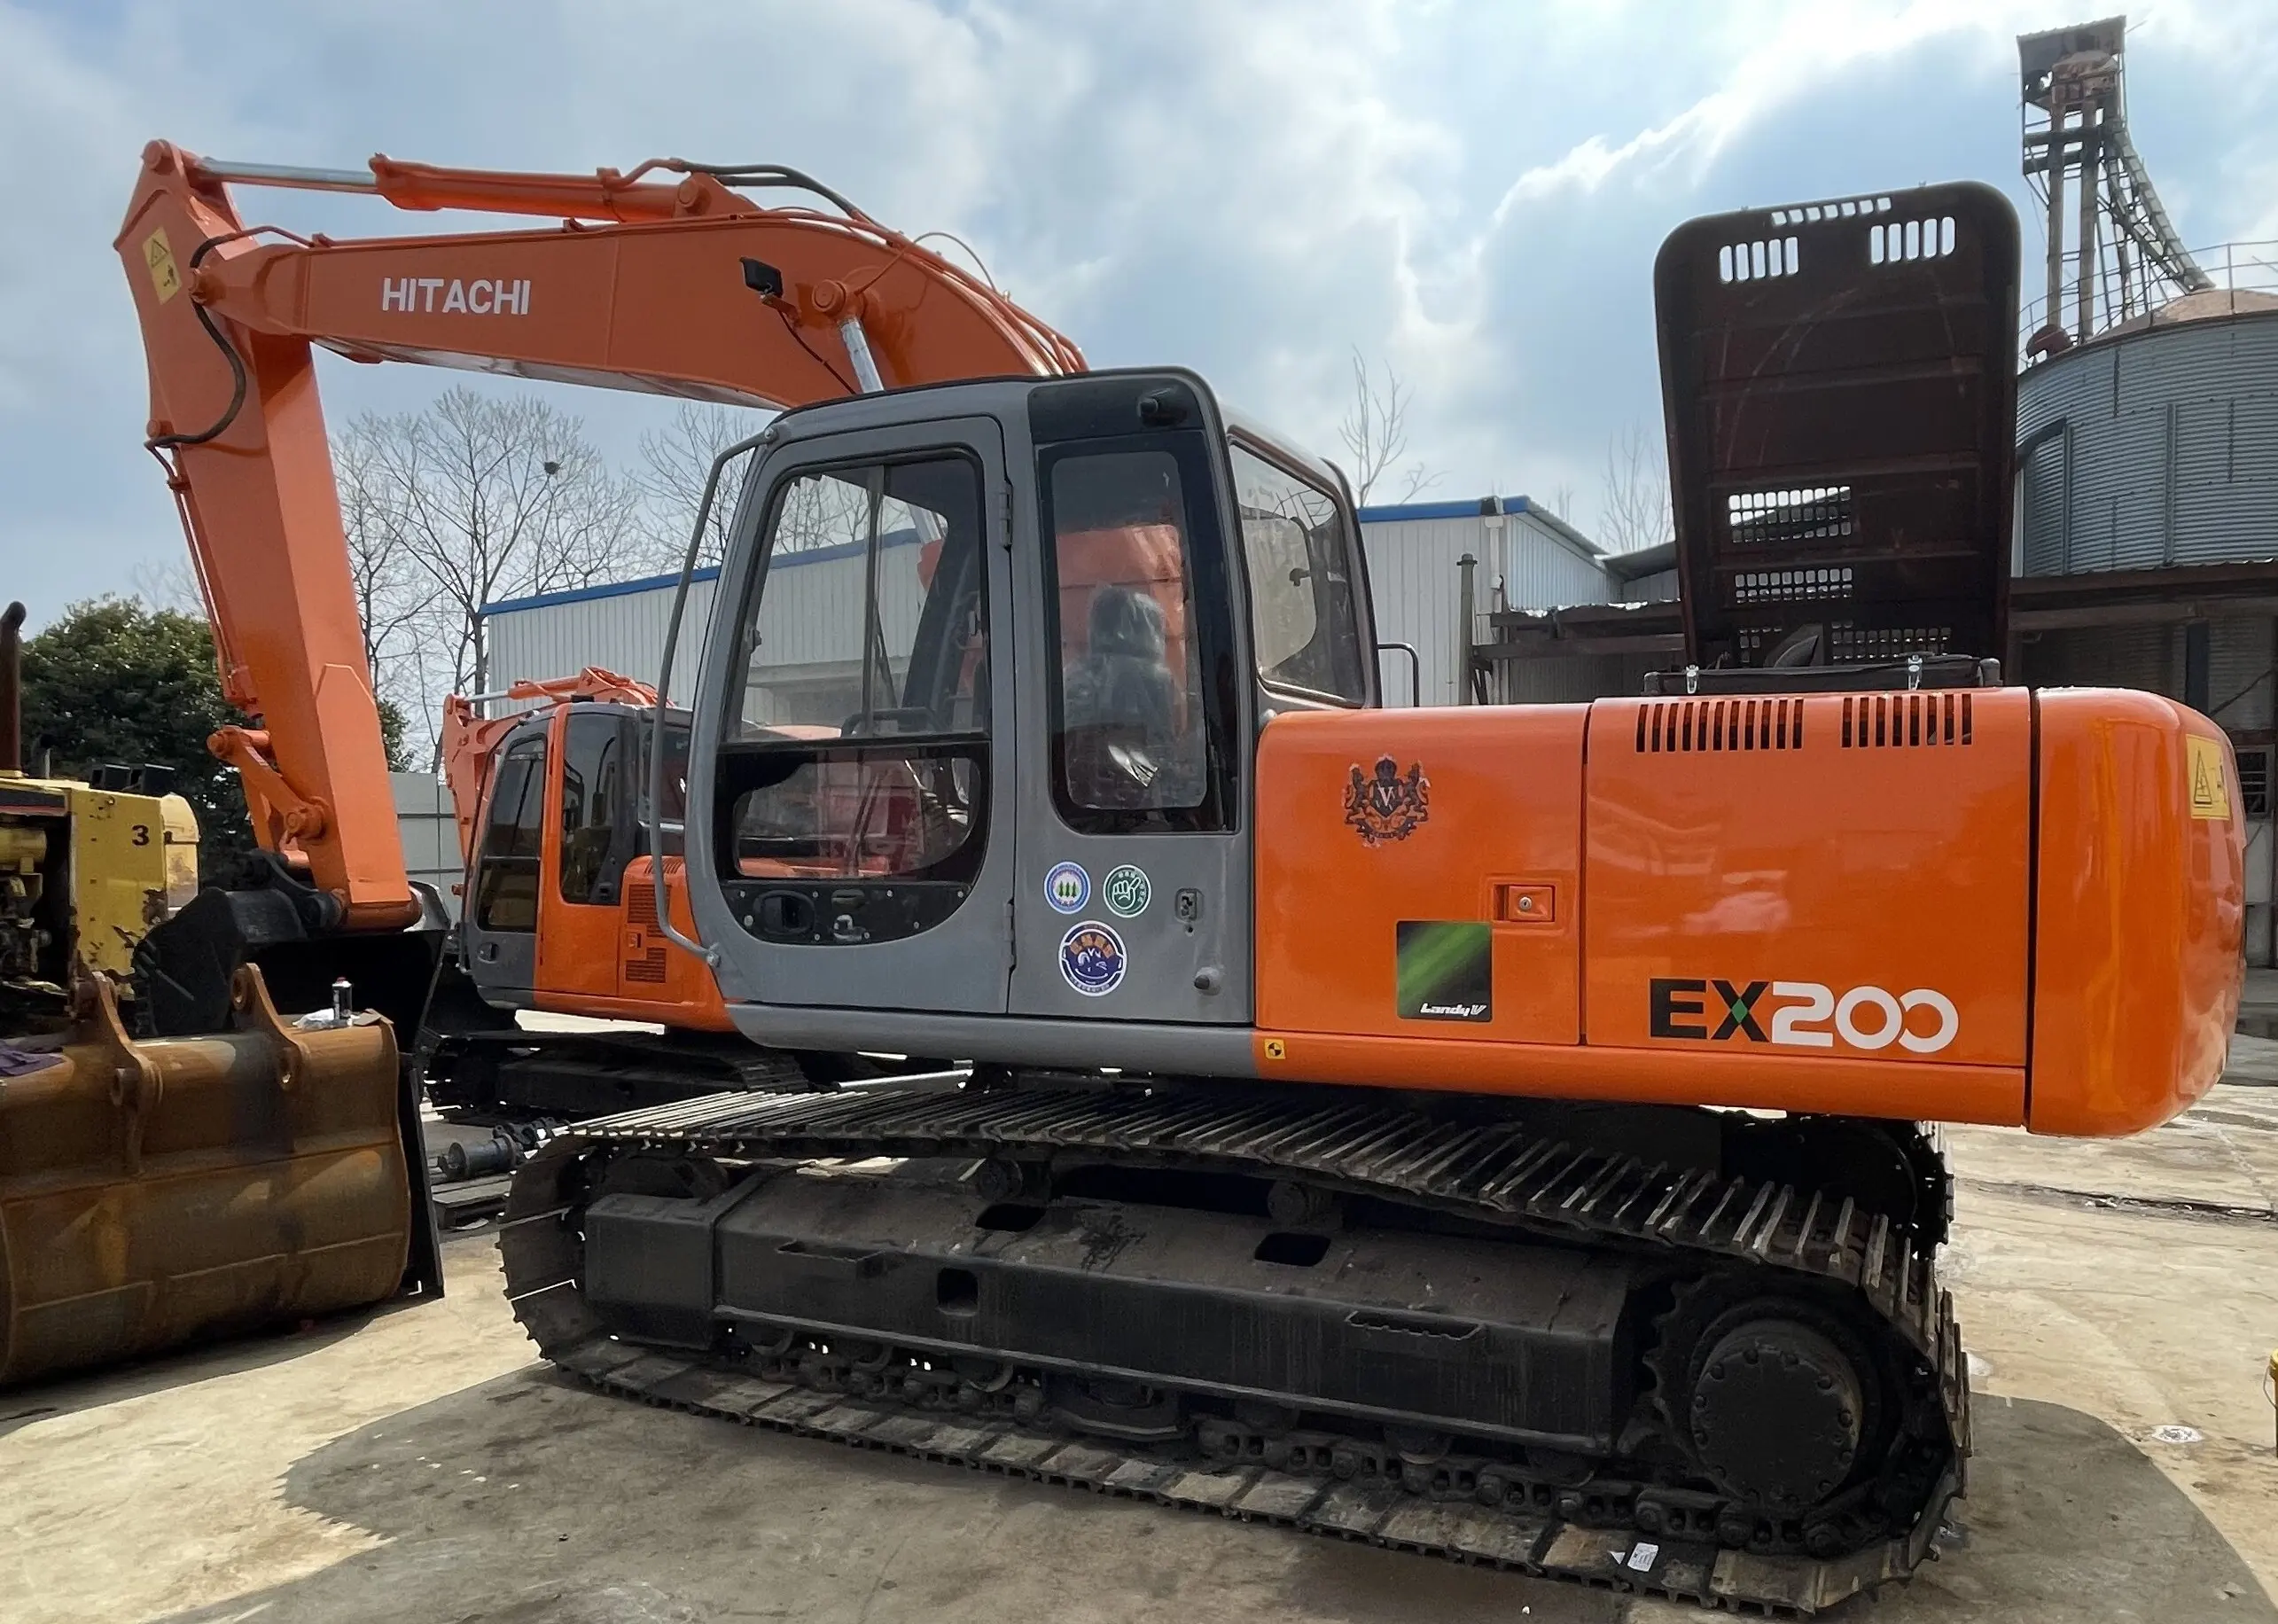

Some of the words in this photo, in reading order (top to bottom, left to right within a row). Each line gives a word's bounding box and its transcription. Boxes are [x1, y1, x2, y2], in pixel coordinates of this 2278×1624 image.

[382, 277, 530, 315] HITACHI
[131, 824, 150, 846] 3
[1650, 978, 1960, 1053] EX200
